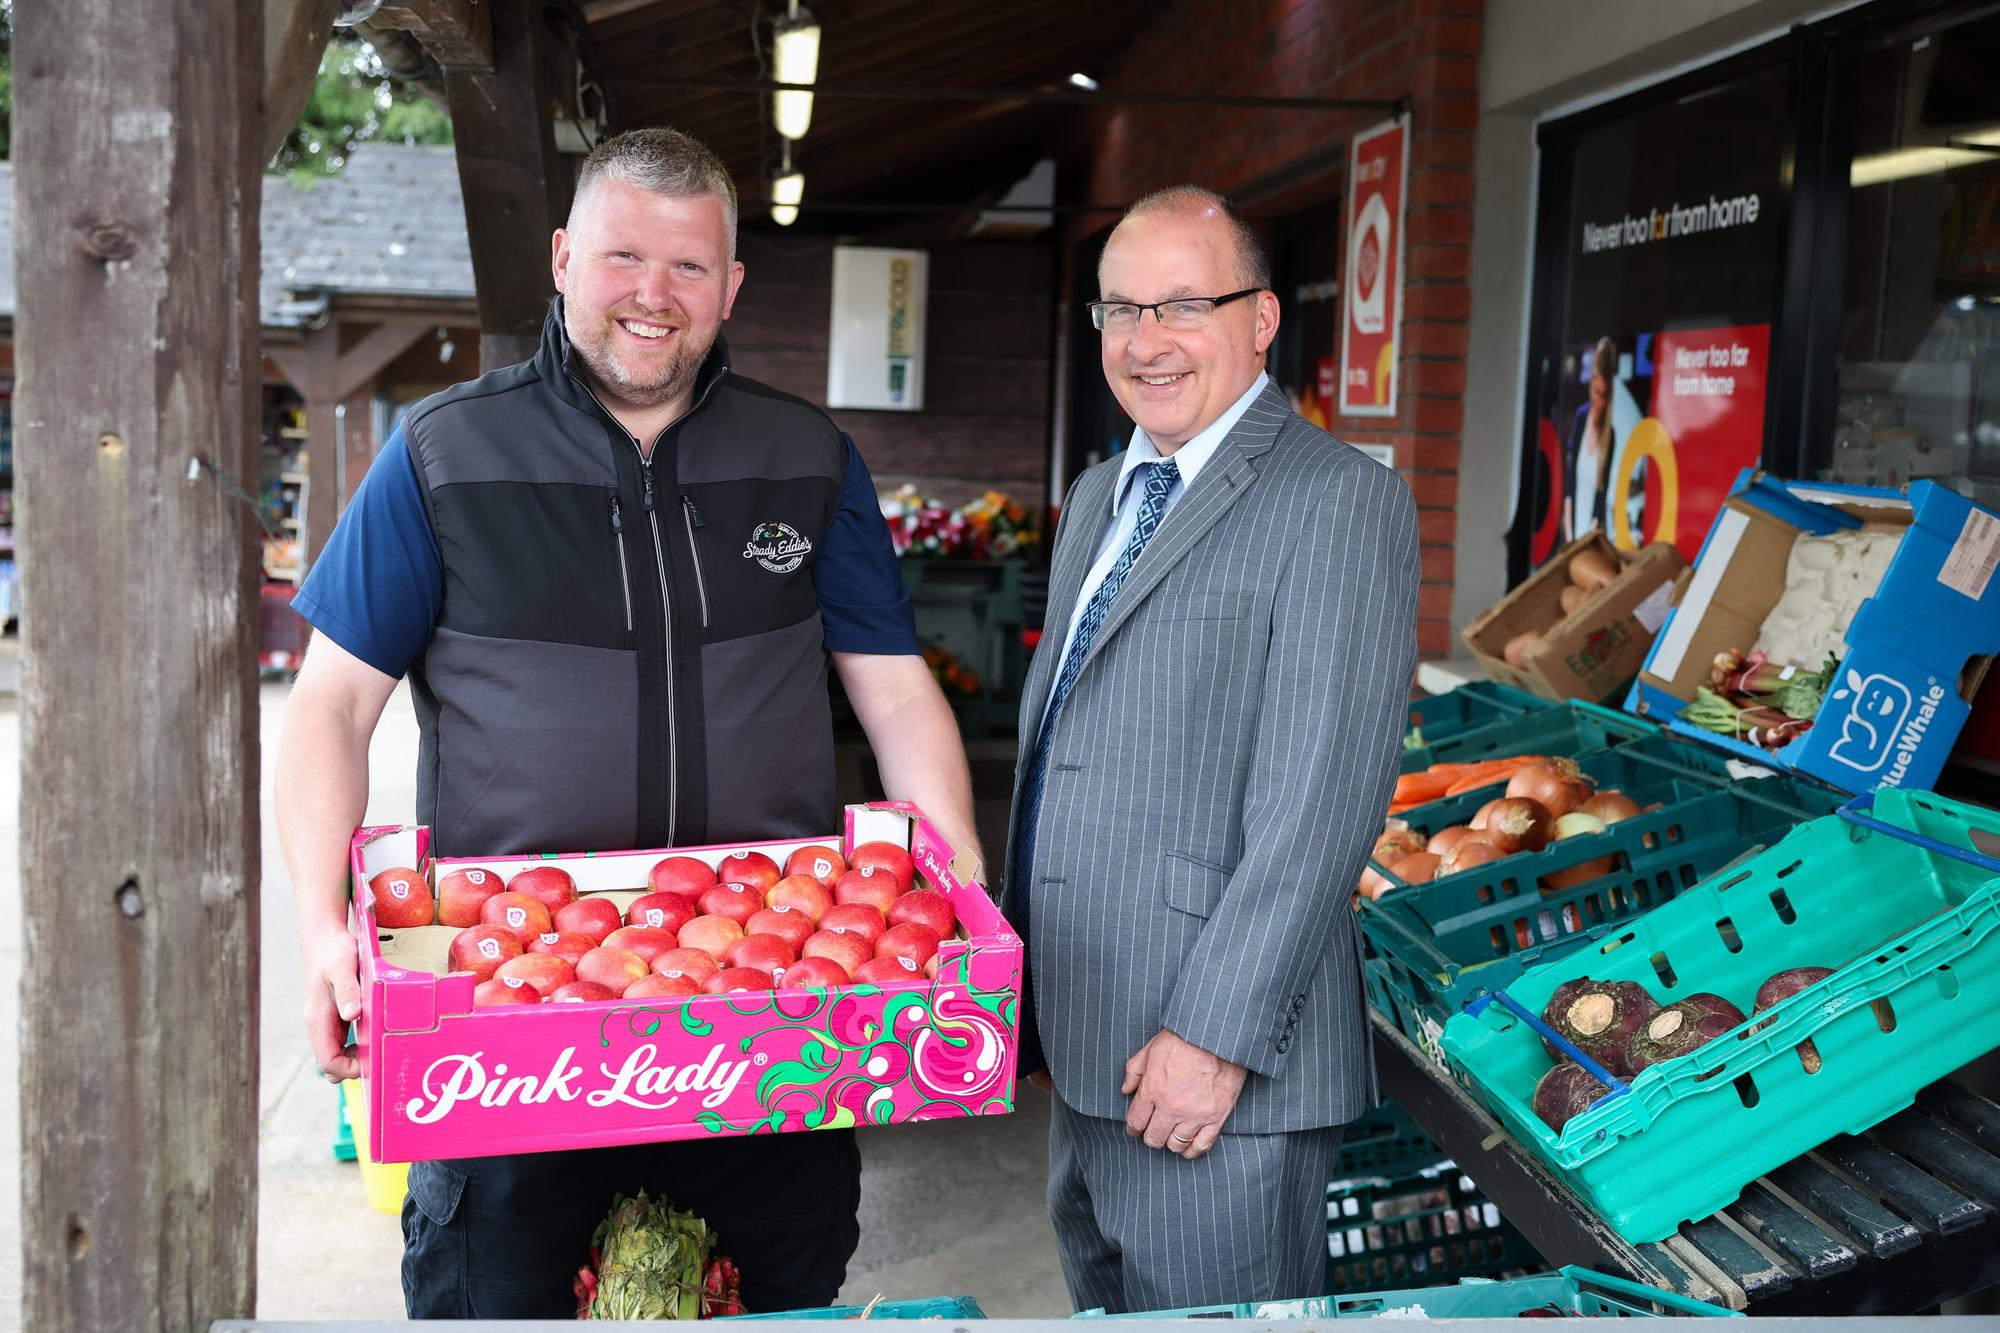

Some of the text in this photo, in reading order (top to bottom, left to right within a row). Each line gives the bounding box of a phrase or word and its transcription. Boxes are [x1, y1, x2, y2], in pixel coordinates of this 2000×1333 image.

[1582, 194, 1760, 254] Never too far from home
[1676, 342, 1750, 369] Never too far
[1701, 373, 1735, 396] home
[754, 526, 766, 541] LOCAL
[777, 524, 799, 539] QUALITY
[743, 536, 812, 560] Steady Eddie's
[405, 1045, 583, 1124] Pink
